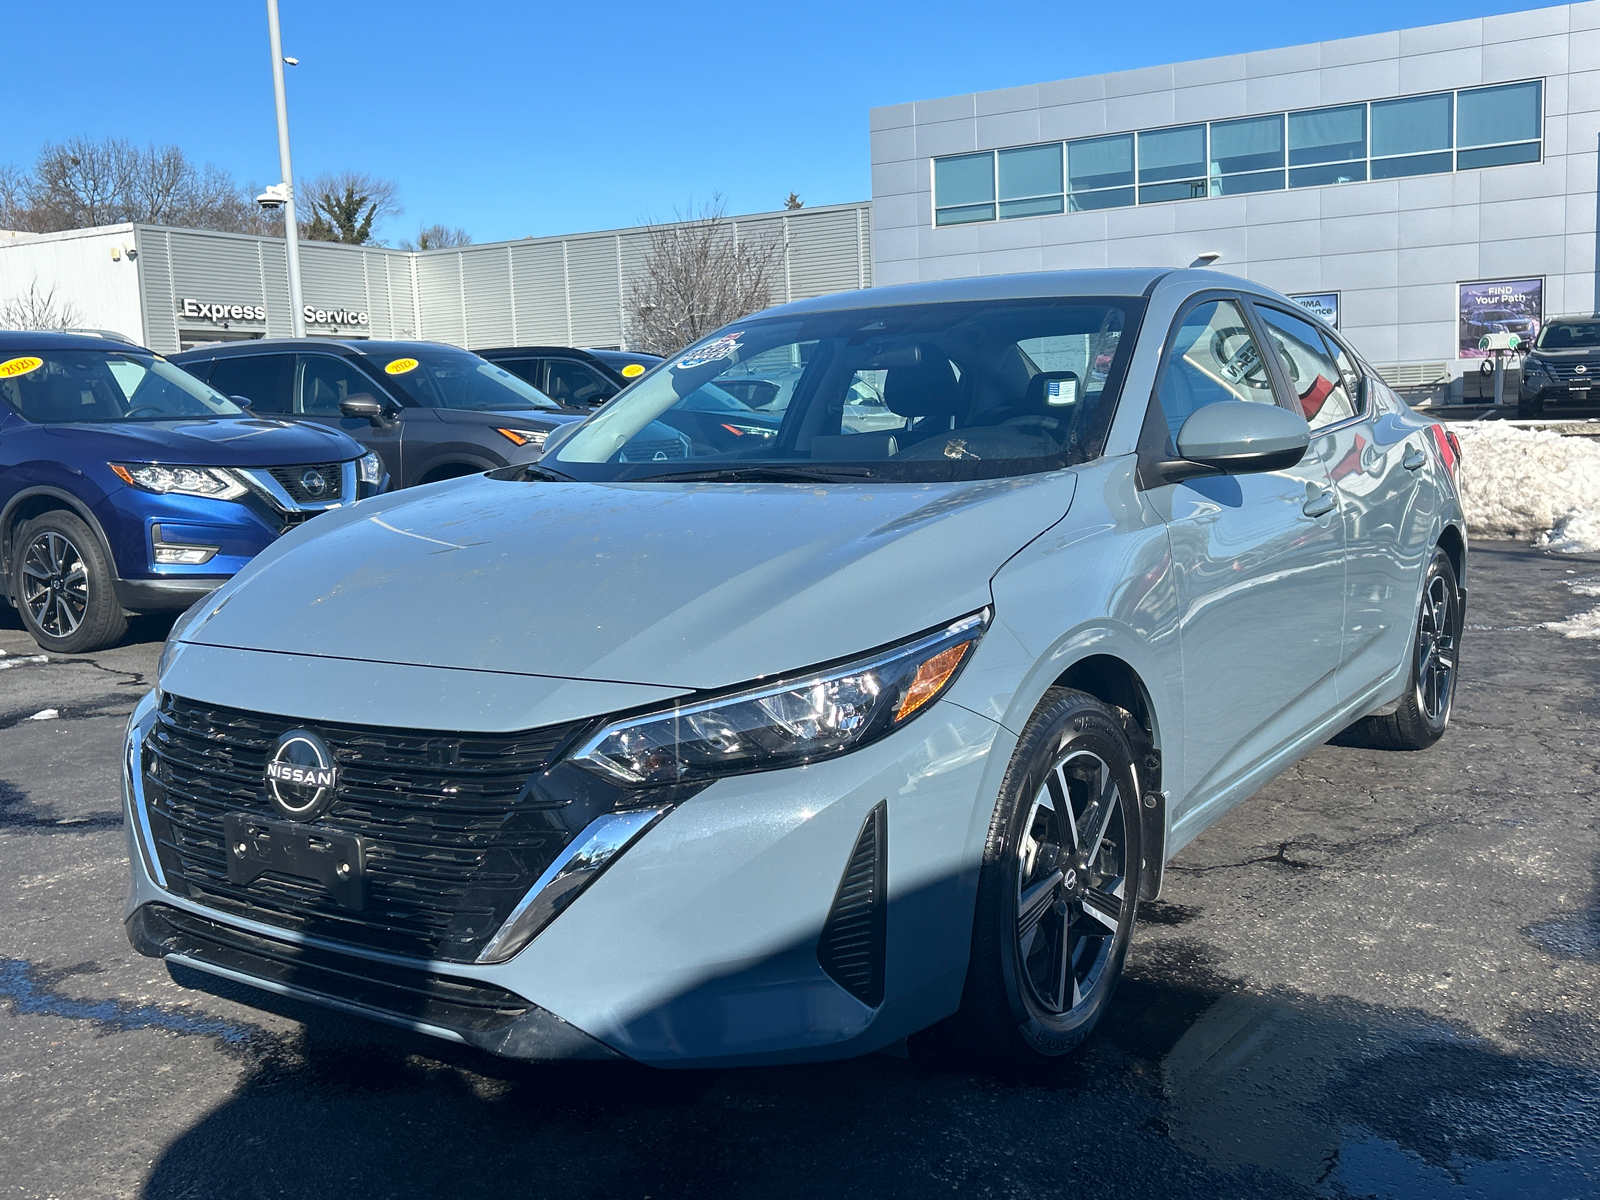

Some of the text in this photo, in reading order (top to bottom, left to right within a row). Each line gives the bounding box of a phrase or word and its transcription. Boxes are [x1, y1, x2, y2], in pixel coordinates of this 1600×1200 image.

[1488, 286, 1513, 296] FIND
[1475, 293, 1526, 305] Your Path
[183, 298, 369, 325] Express Service
[1312, 308, 1333, 316] nce
[2, 359, 35, 375] 2020
[267, 763, 331, 785] NISSAN
